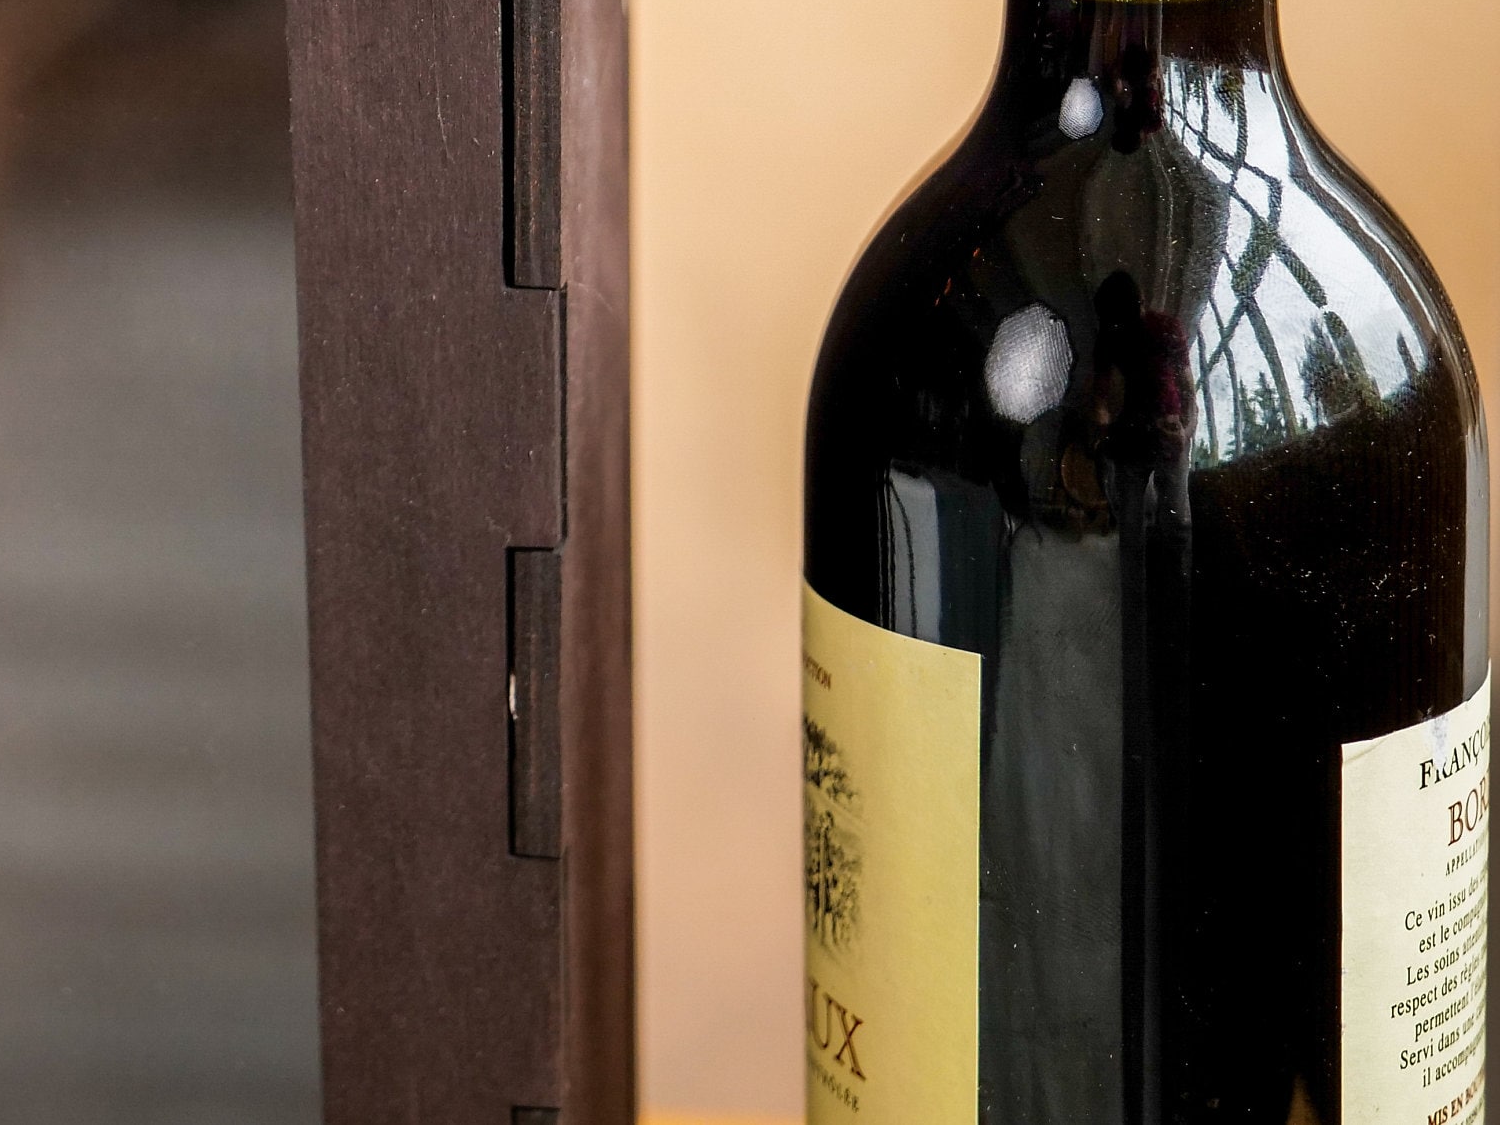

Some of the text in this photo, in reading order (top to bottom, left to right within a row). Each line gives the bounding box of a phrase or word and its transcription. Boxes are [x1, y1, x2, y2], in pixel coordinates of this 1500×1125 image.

[1405, 911, 1423, 932] Ce
[1428, 900, 1446, 922] vin
[1449, 888, 1466, 912] issu
[1419, 934, 1437, 954] est
[1440, 925, 1450, 945] le
[1406, 965, 1430, 986] Les
[1434, 948, 1460, 975] soins
[1391, 987, 1438, 1019] respect
[1441, 976, 1458, 997] des
[1414, 991, 1469, 1042] permettent
[1399, 1037, 1434, 1070] Servi
[1437, 1027, 1460, 1053] dans
[1422, 1067, 1431, 1088] il
[1427, 1104, 1448, 1125] MIS
[1450, 1092, 1464, 1118] EN
